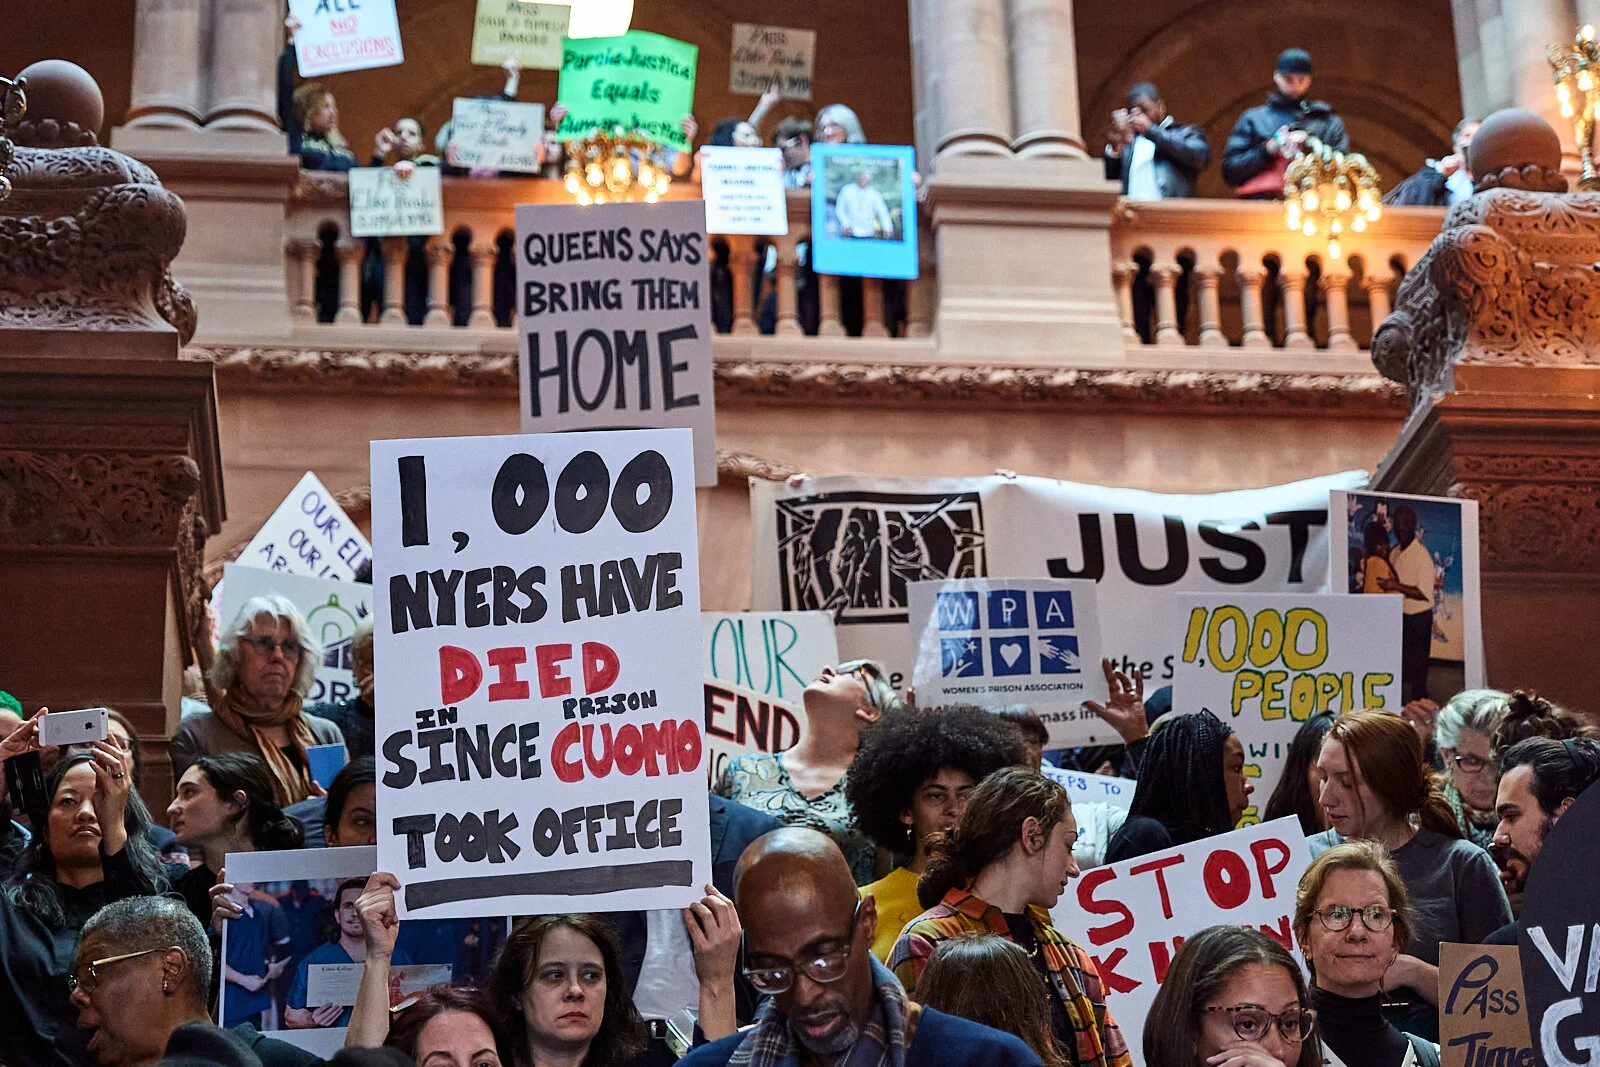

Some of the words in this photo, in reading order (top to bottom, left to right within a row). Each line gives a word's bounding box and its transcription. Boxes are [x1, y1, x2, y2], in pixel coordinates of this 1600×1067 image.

[590, 79, 659, 104] Equals
[523, 227, 634, 267] QUEENS
[638, 229, 702, 265] SAYS
[523, 278, 624, 317] BRING
[631, 277, 700, 311] THEM
[527, 324, 700, 418] HOME
[301, 490, 341, 544] OUR
[398, 449, 673, 553] 1,000
[259, 543, 294, 574] AR
[289, 528, 322, 570] OUR
[1046, 509, 1329, 586] JUST
[390, 565, 548, 634] NYERS
[560, 552, 683, 623] HAVE
[710, 618, 807, 698] OUR
[1182, 604, 1329, 673] 1,000
[438, 641, 621, 705] DIED
[942, 686, 986, 695] WOMEN'S
[988, 684, 1023, 693] PRISON
[1024, 683, 1084, 692] ASSOCIATION
[1111, 655, 1154, 680] the
[415, 707, 458, 729] IN
[562, 690, 658, 719] PRISON
[703, 683, 800, 754] END
[1040, 710, 1076, 723] mass
[1231, 668, 1394, 722] PEOPLE
[381, 721, 541, 789] SINCE
[550, 719, 703, 783] CUOMO
[1100, 782, 1121, 795] TO
[392, 809, 521, 869] TOOK
[532, 798, 683, 857] OFFICE
[1076, 838, 1291, 946] STOP
